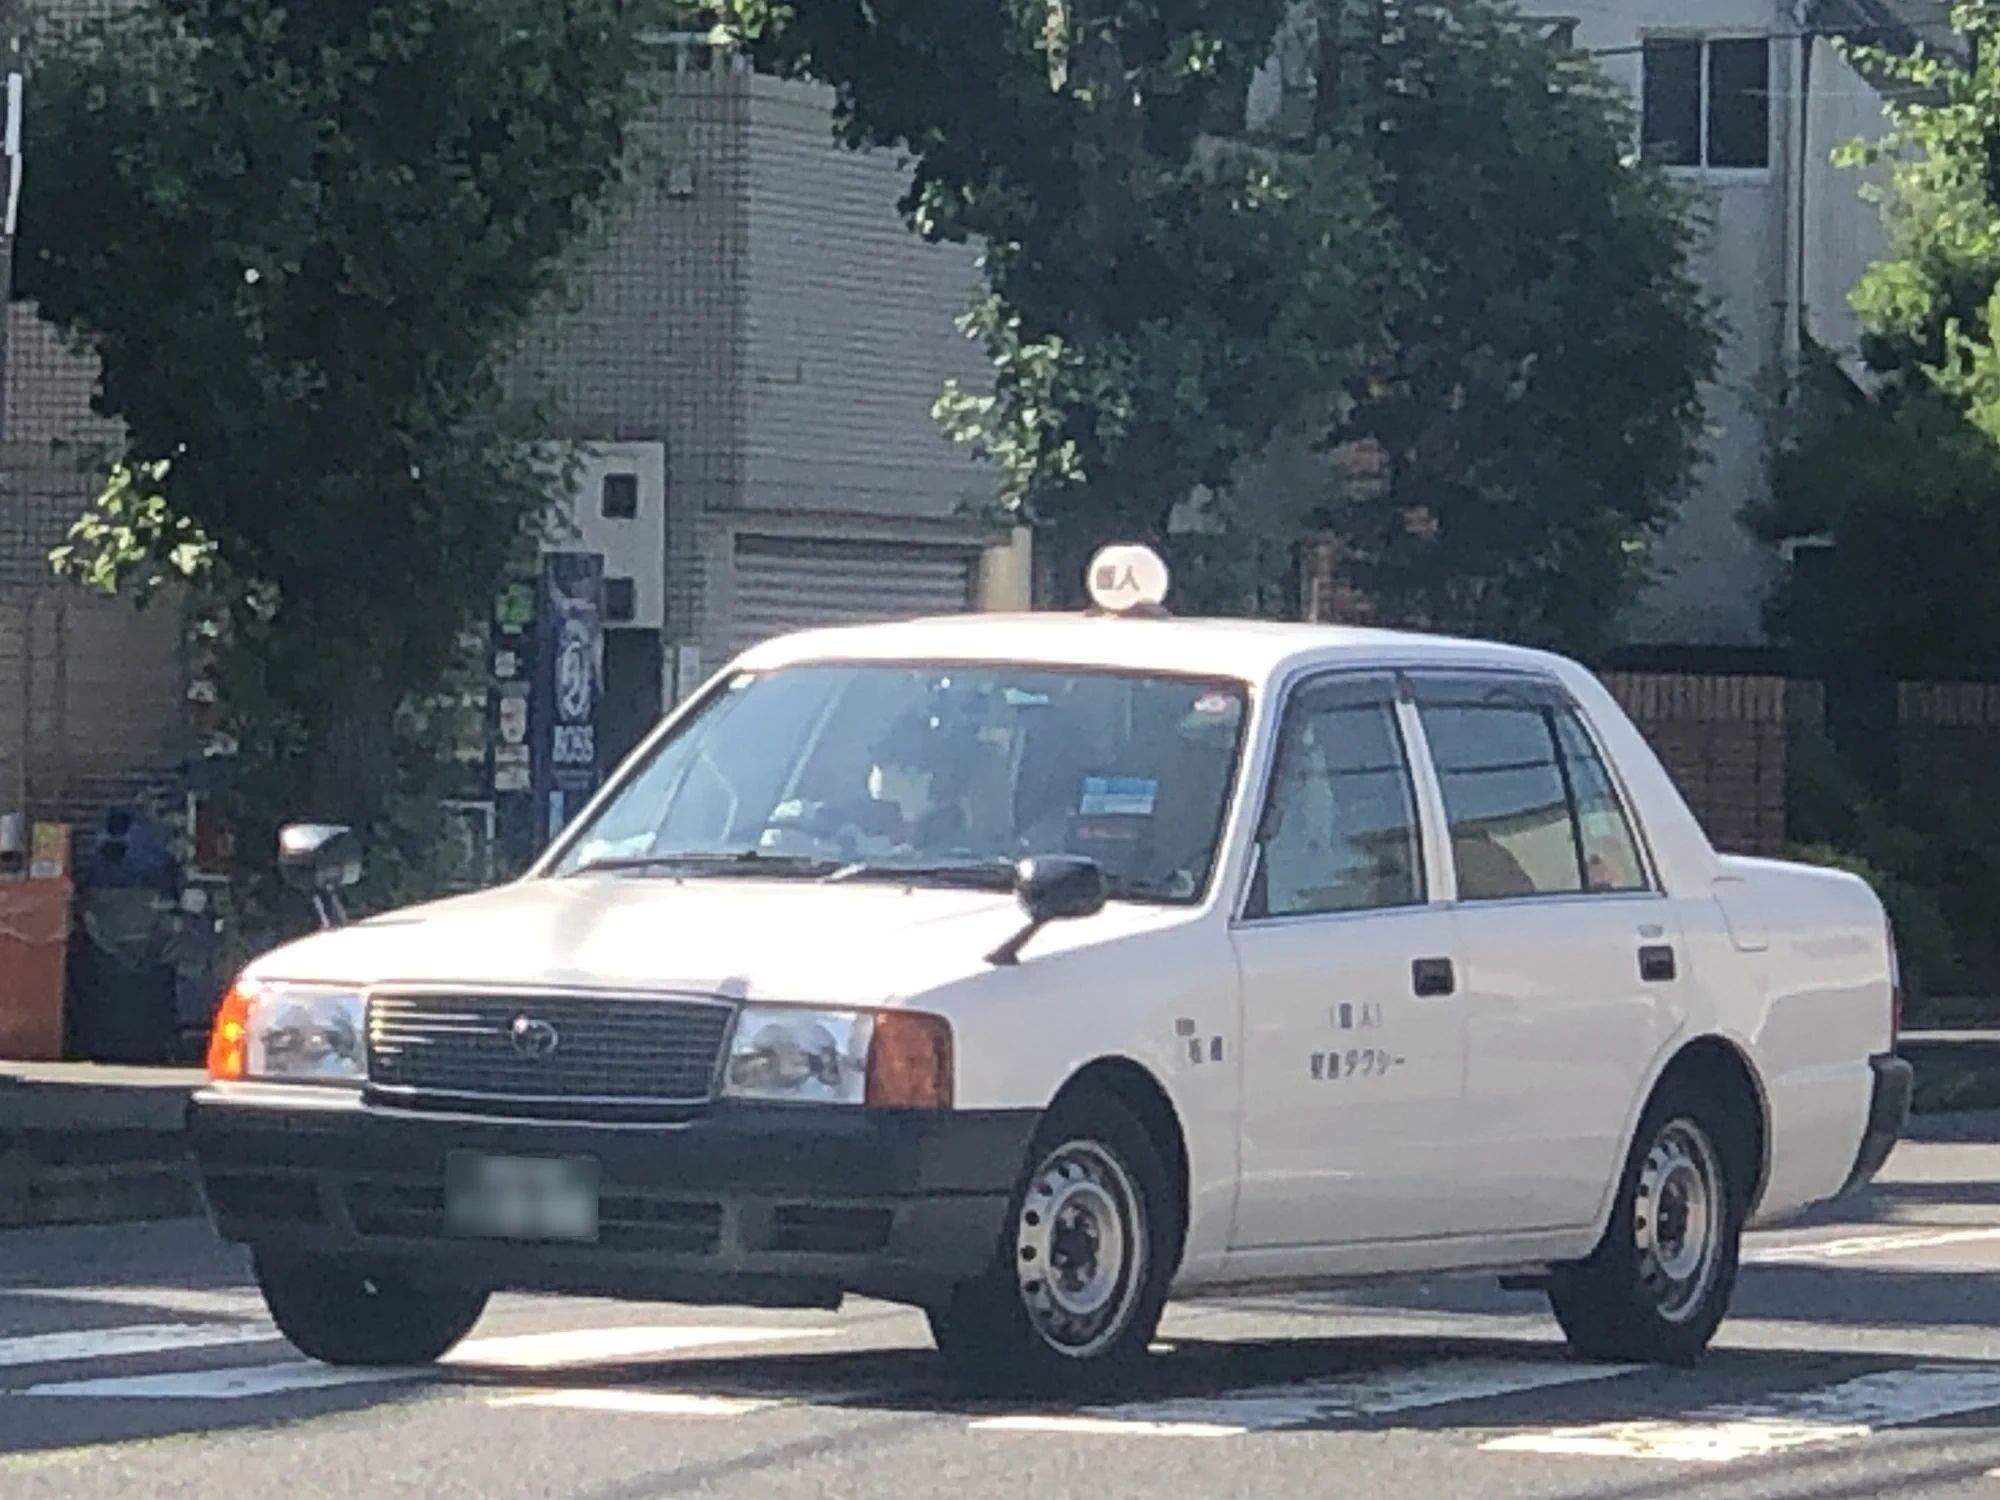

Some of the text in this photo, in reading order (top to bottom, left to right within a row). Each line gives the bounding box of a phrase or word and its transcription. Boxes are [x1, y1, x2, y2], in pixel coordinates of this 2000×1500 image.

[1096, 565, 1140, 592] 人
[1310, 1049, 1405, 1080] タクシー
